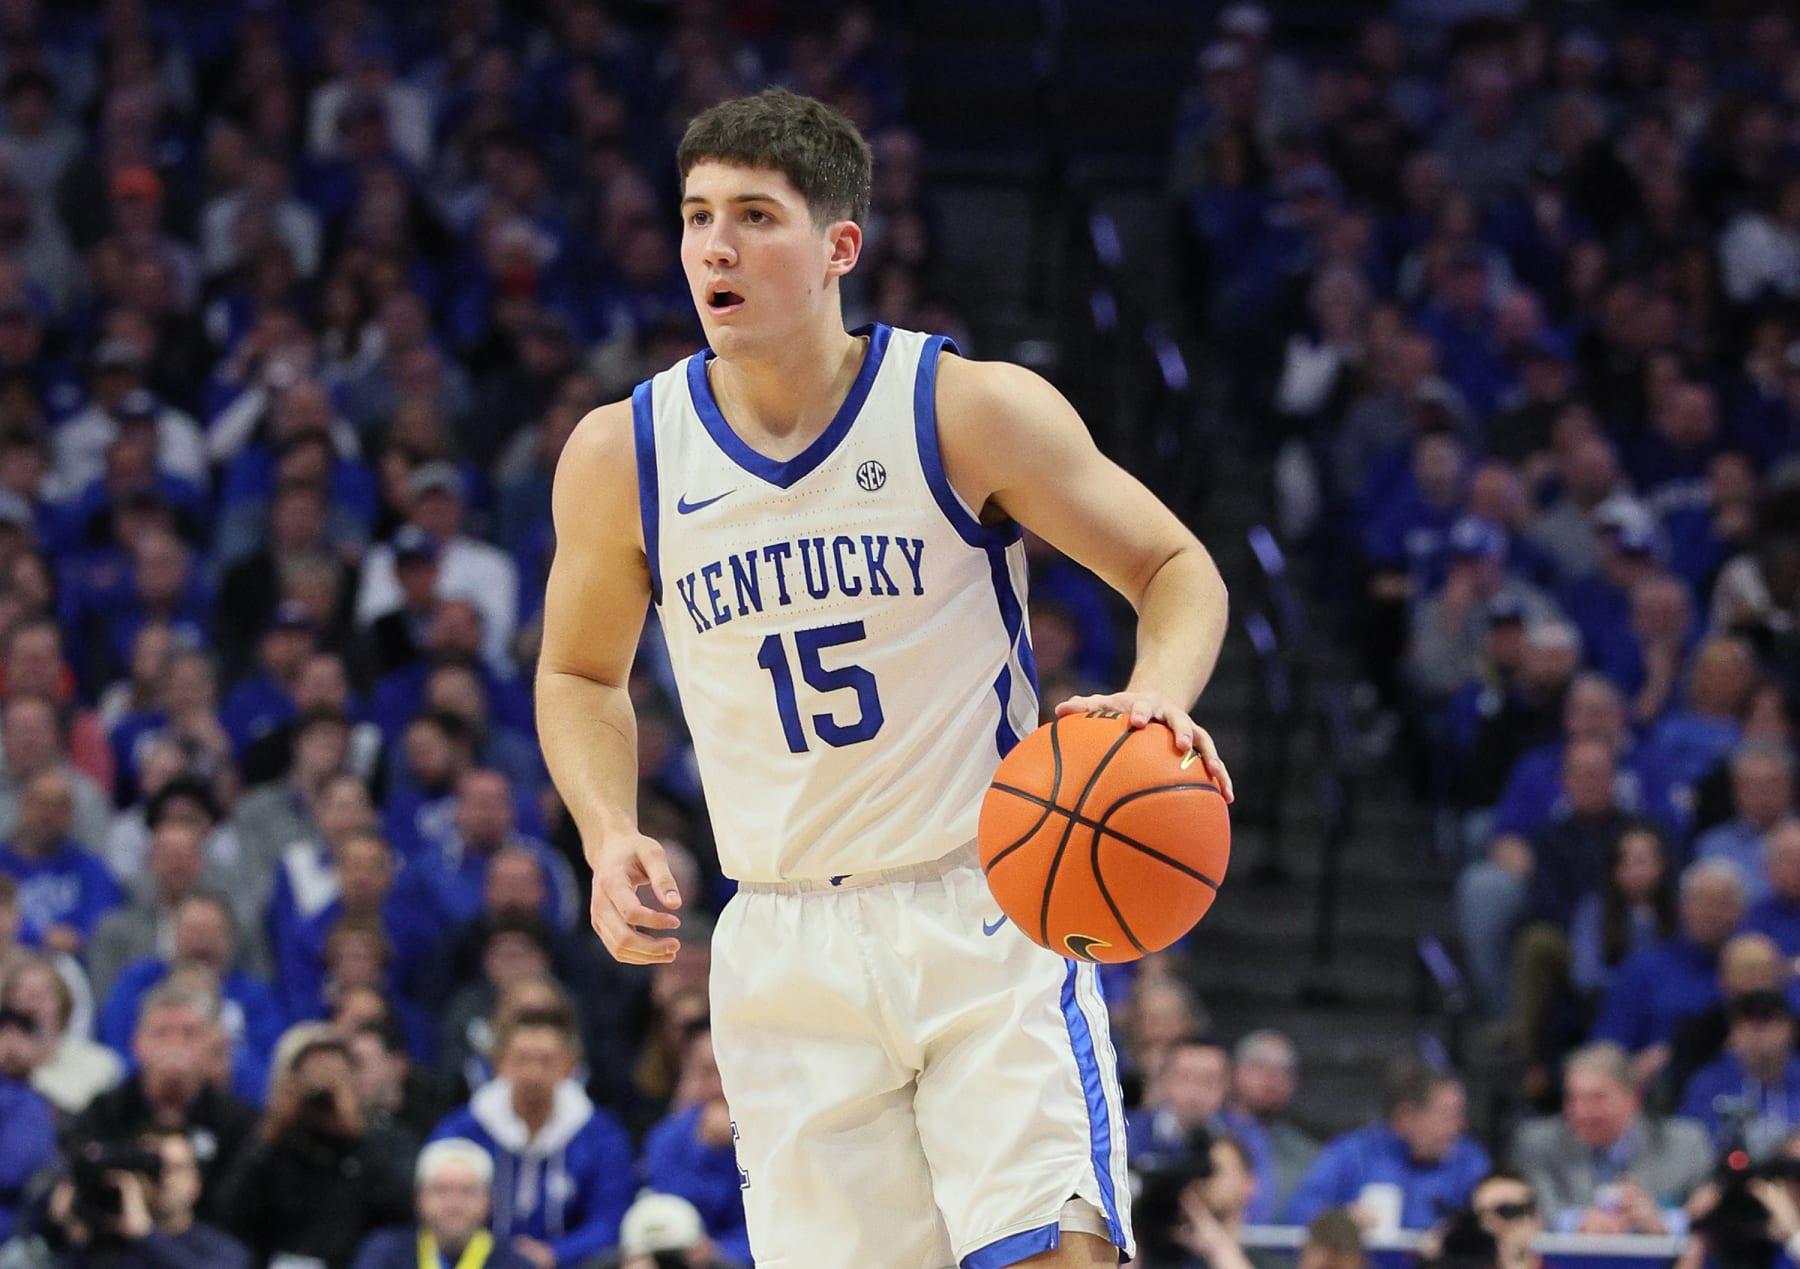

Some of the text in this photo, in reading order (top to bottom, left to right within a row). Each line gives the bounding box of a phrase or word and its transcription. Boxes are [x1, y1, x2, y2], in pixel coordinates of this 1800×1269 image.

[857, 461, 886, 490] SEC
[676, 535, 925, 633] KENTUCKY
[757, 620, 885, 753] 15
